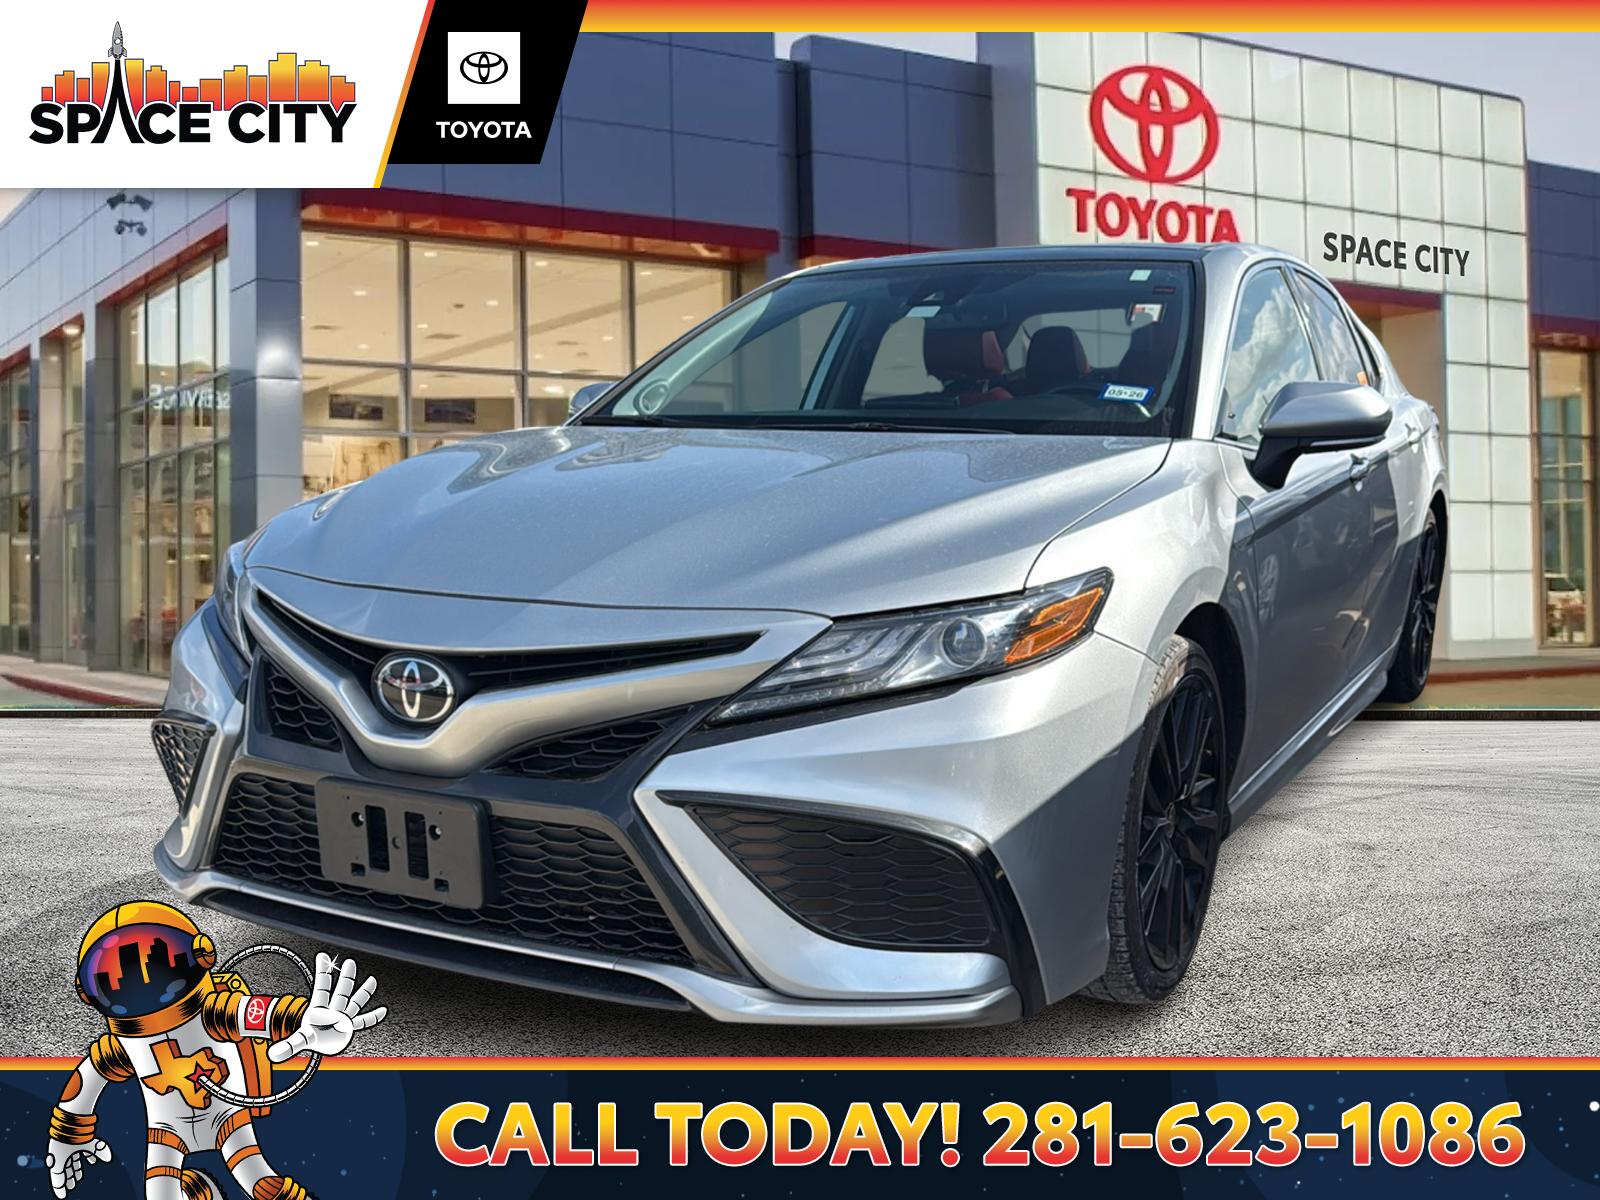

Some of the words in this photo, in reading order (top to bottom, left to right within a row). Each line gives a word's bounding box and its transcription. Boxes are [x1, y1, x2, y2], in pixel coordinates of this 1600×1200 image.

[1066, 188, 1240, 243] TOYOTA
[1323, 232, 1407, 270] SPACE
[1414, 244, 1470, 277] CITY
